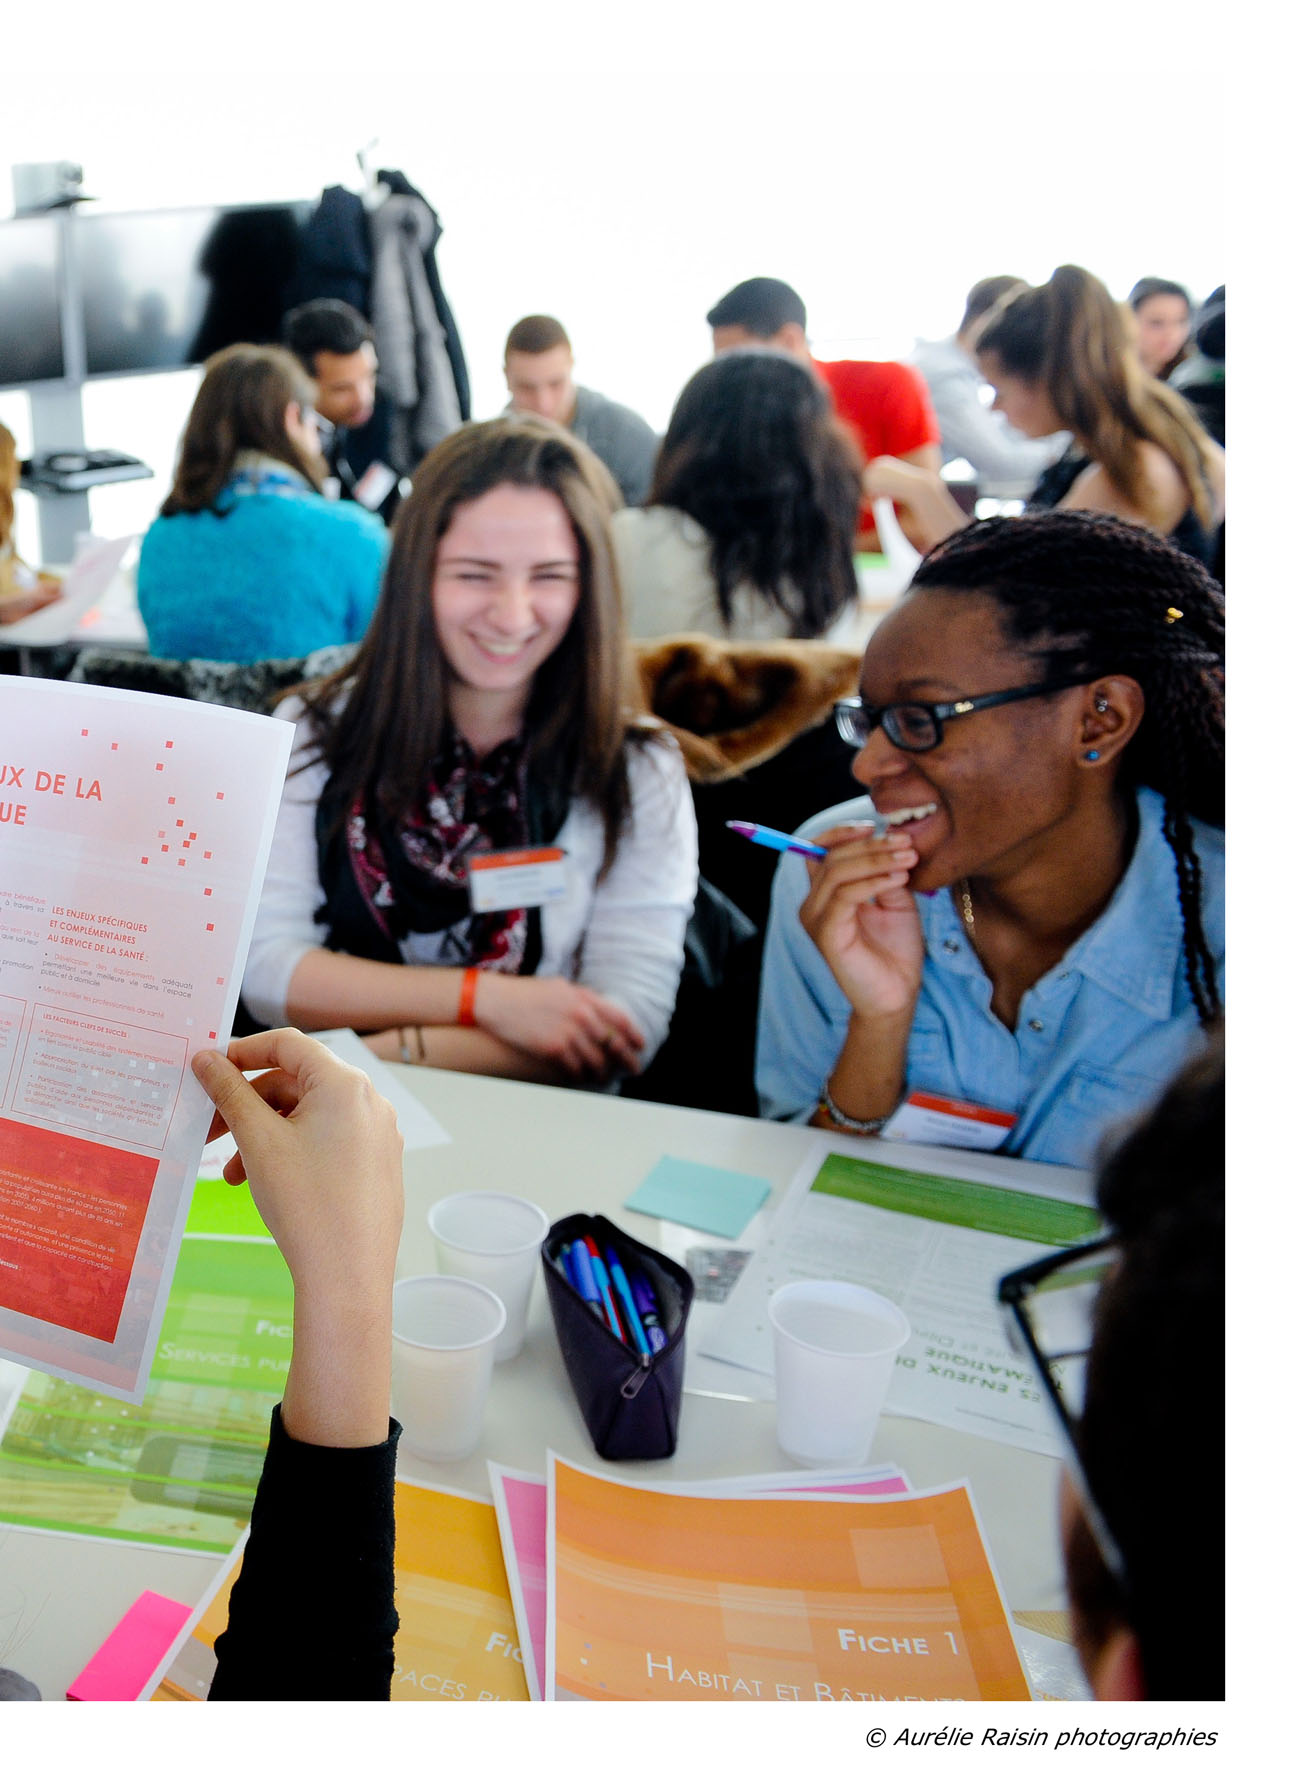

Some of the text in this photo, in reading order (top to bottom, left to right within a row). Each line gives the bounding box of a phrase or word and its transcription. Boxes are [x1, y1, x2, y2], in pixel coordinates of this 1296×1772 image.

[35, 771, 66, 795] DE
[75, 777, 103, 801] LA
[50, 919, 136, 945] ET COMPLÉMENTAIRES
[52, 906, 148, 934] LES ENJEUX SPÉCIFIQUES
[48, 933, 145, 961] AU SERVICE DE LA SANTÉ
[485, 1631, 523, 1664] FIC
[837, 1628, 959, 1656] FICHE 1
[646, 1652, 763, 1697] HABITAT
[775, 1683, 801, 1701] ET
